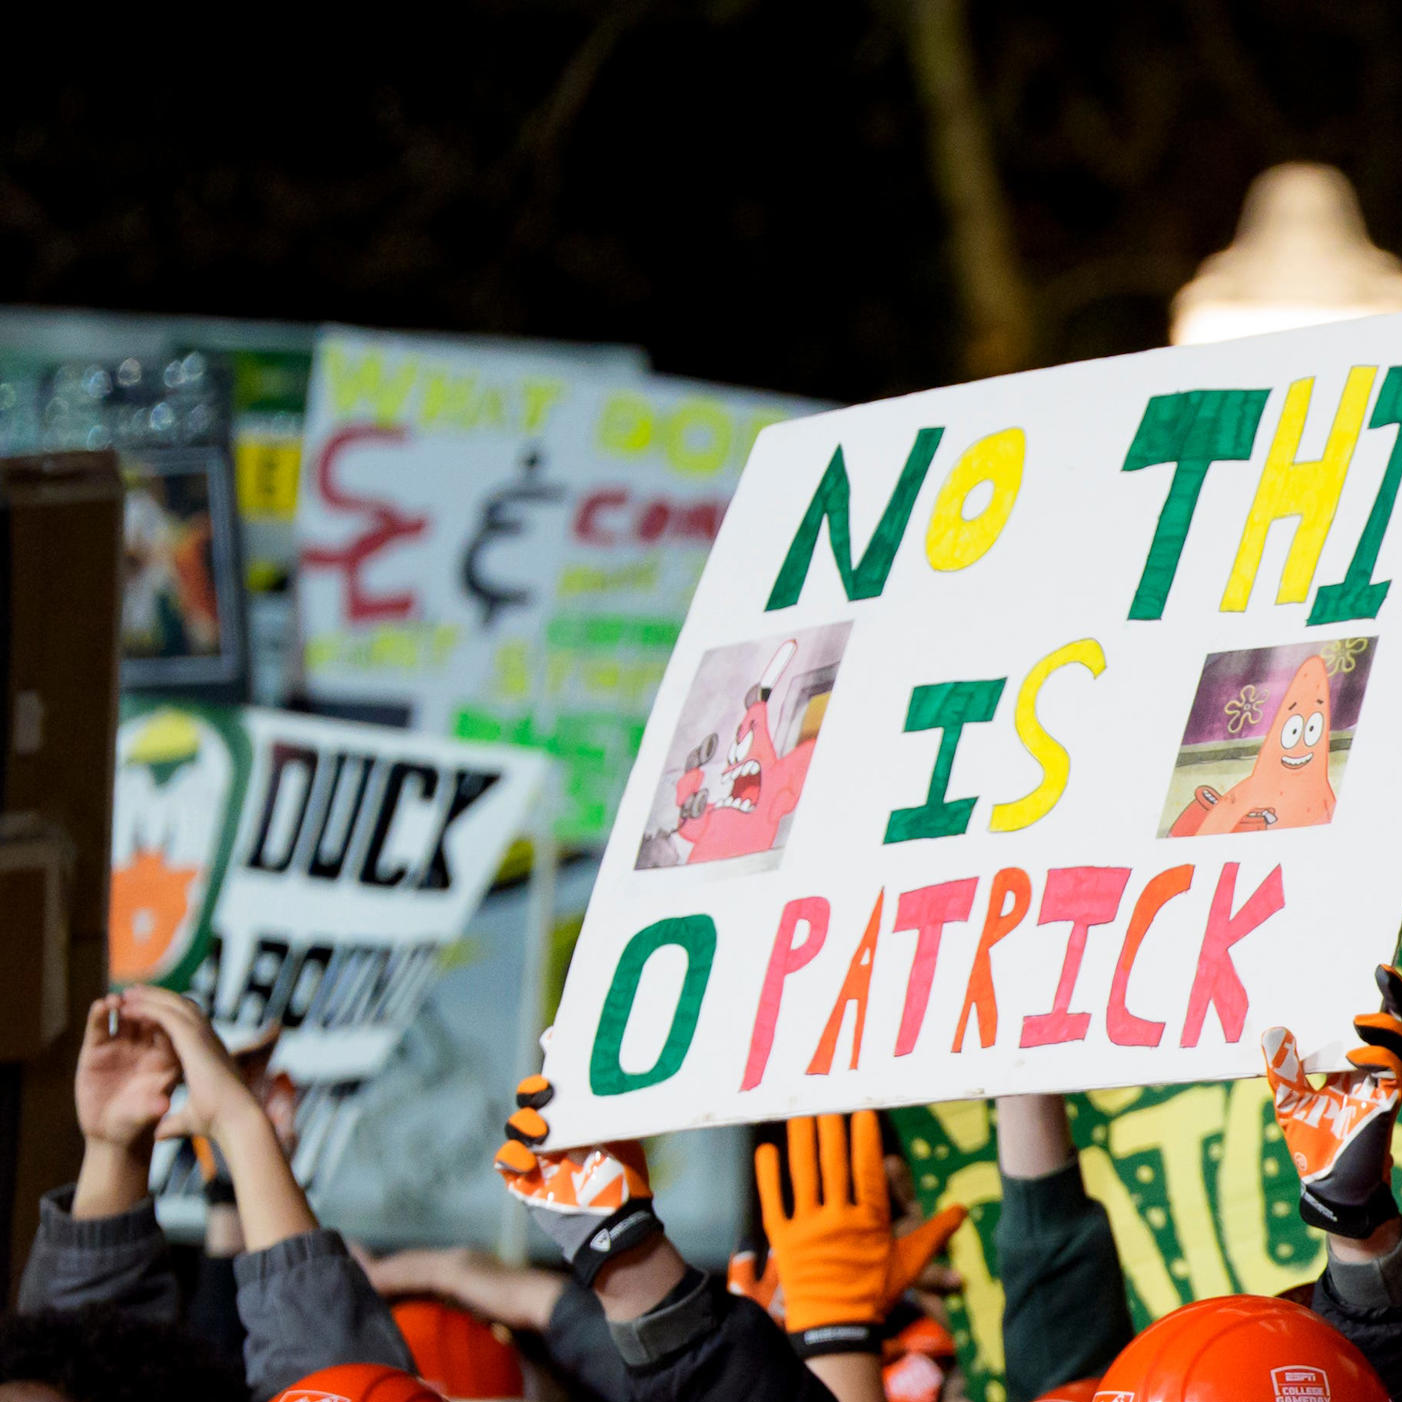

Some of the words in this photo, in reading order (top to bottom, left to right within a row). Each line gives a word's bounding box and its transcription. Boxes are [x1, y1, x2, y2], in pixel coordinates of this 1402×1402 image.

[764, 424, 1026, 612] NO
[249, 742, 504, 891] DUCK
[882, 637, 1108, 844] IS
[588, 912, 717, 1097] O
[738, 860, 1287, 1092] PATRICK
[1281, 1386, 1323, 1395] COLLEGE
[1285, 1372, 1316, 1382] ESPN
